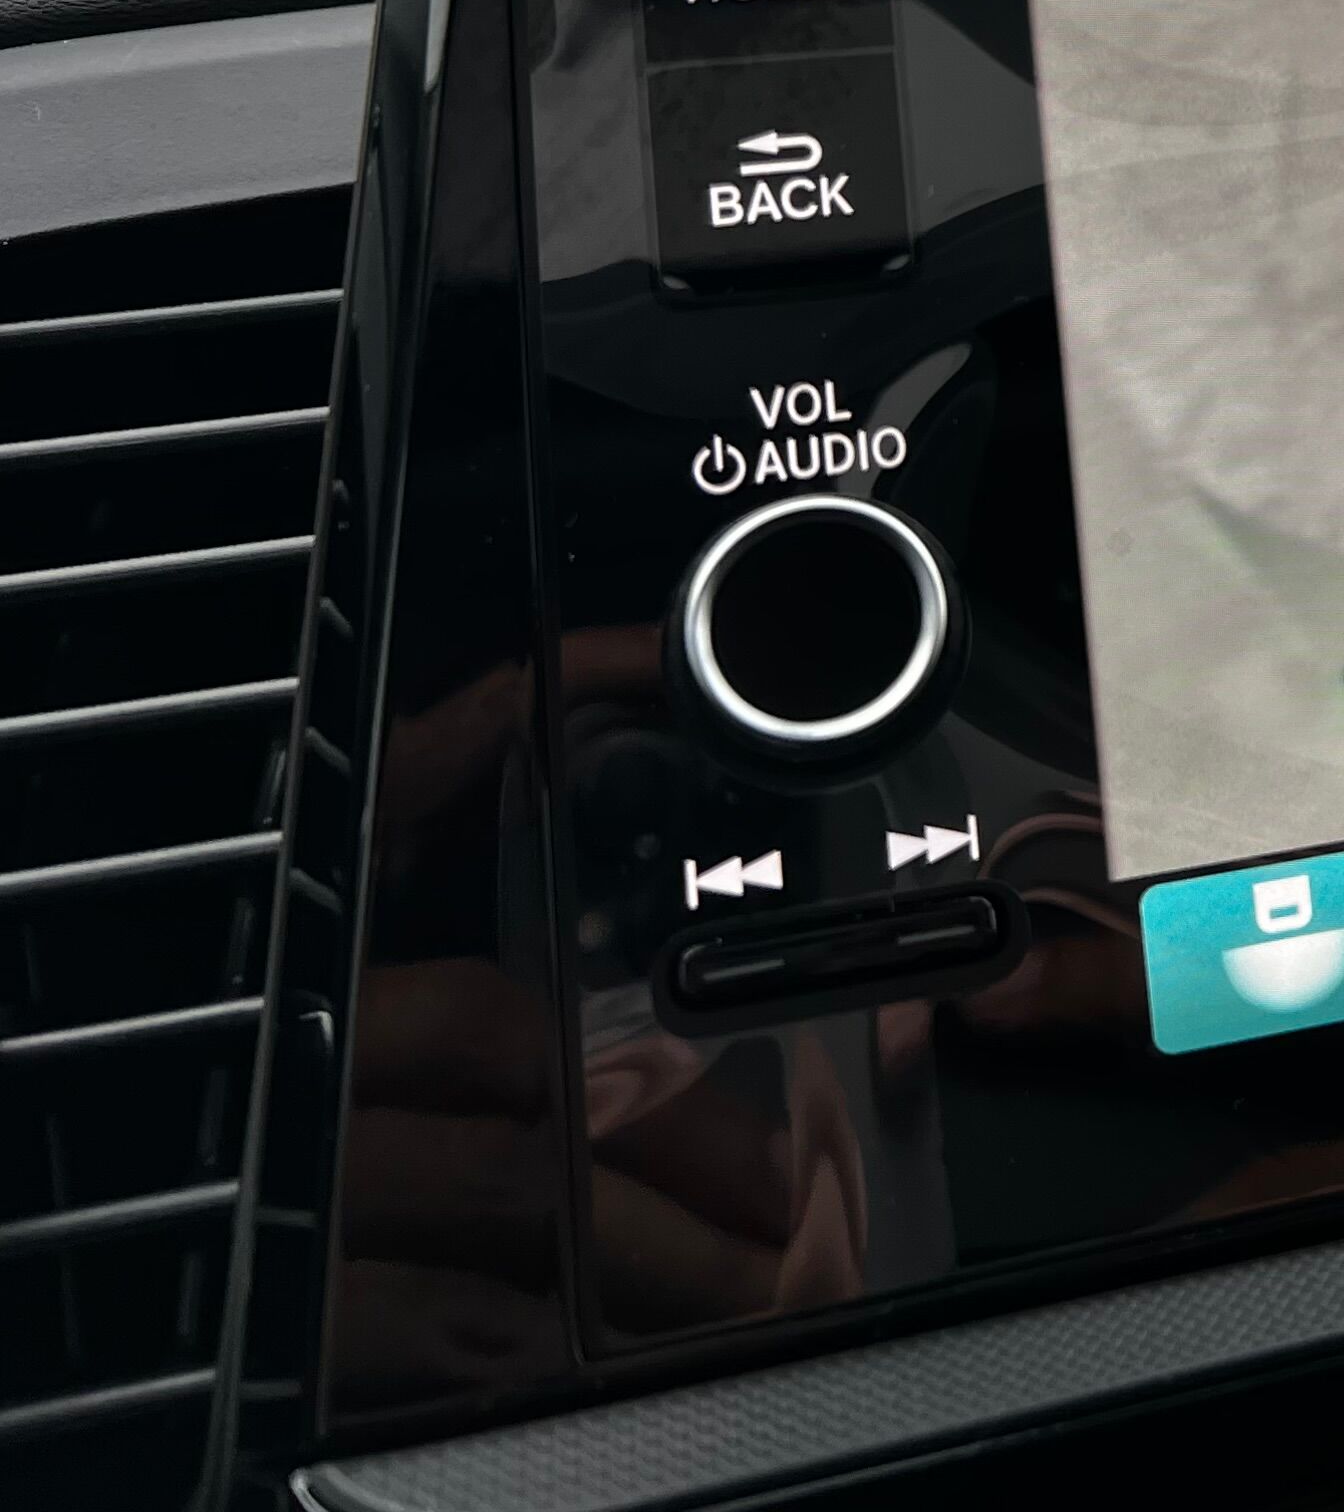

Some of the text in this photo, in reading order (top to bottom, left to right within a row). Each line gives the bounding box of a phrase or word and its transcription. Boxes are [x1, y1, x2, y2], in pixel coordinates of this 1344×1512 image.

[708, 173, 855, 229] BACK
[749, 380, 852, 430] VOL
[755, 425, 908, 486] AUDIO
